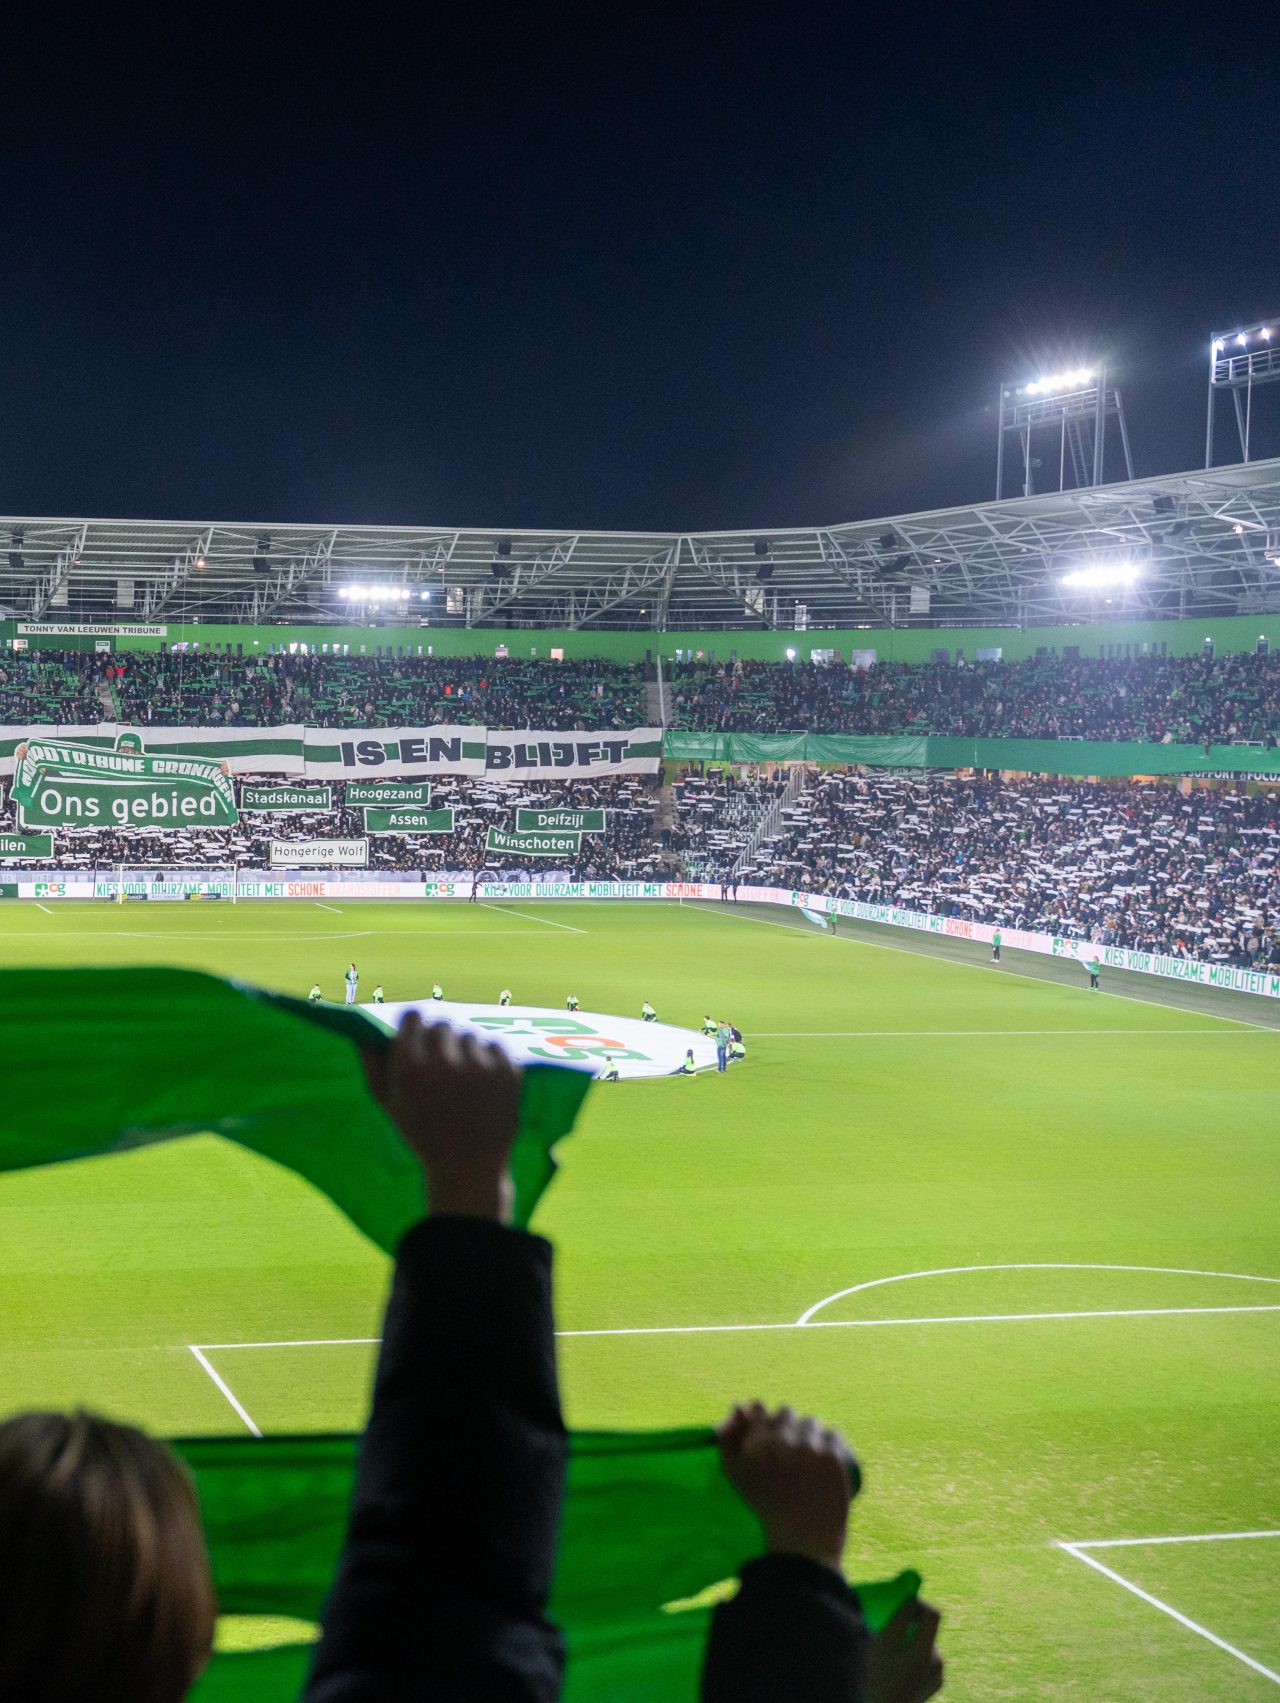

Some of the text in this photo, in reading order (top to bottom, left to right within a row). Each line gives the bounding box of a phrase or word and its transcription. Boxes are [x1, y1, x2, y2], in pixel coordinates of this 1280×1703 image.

[24, 625, 161, 634] TONNY VAN LEEUWEN TRIBUNE
[340, 737, 629, 770] IS EN BLIJFT
[21, 746, 145, 788] NOORDTRIBUNE
[245, 791, 327, 805] Stadskanaal
[349, 787, 423, 801] Hoogezand
[40, 788, 216, 824] Ons gebied
[389, 814, 428, 826] Assen
[537, 814, 584, 827] Delfzijl
[493, 832, 575, 851] Winschoten
[274, 845, 365, 859] Hongerige Wolf
[97, 883, 118, 896] KIES
[124, 883, 147, 895] VOOR
[208, 883, 261, 896] MOBILITEIT
[265, 883, 285, 896] MET
[288, 883, 326, 896] SCHONE
[509, 884, 533, 896] VOOR
[536, 884, 585, 896] DUURZAME
[589, 884, 640, 896] MOBILITEIT
[644, 884, 663, 896] MET
[666, 884, 703, 896] SCHONE
[930, 917, 944, 932] MET
[946, 918, 973, 937] SCHONE
[1105, 948, 1123, 968] KIES
[1127, 953, 1150, 973] VOOR
[1154, 959, 1205, 982] DUURZAME
[1209, 968, 1266, 993] MOBILITEIT
